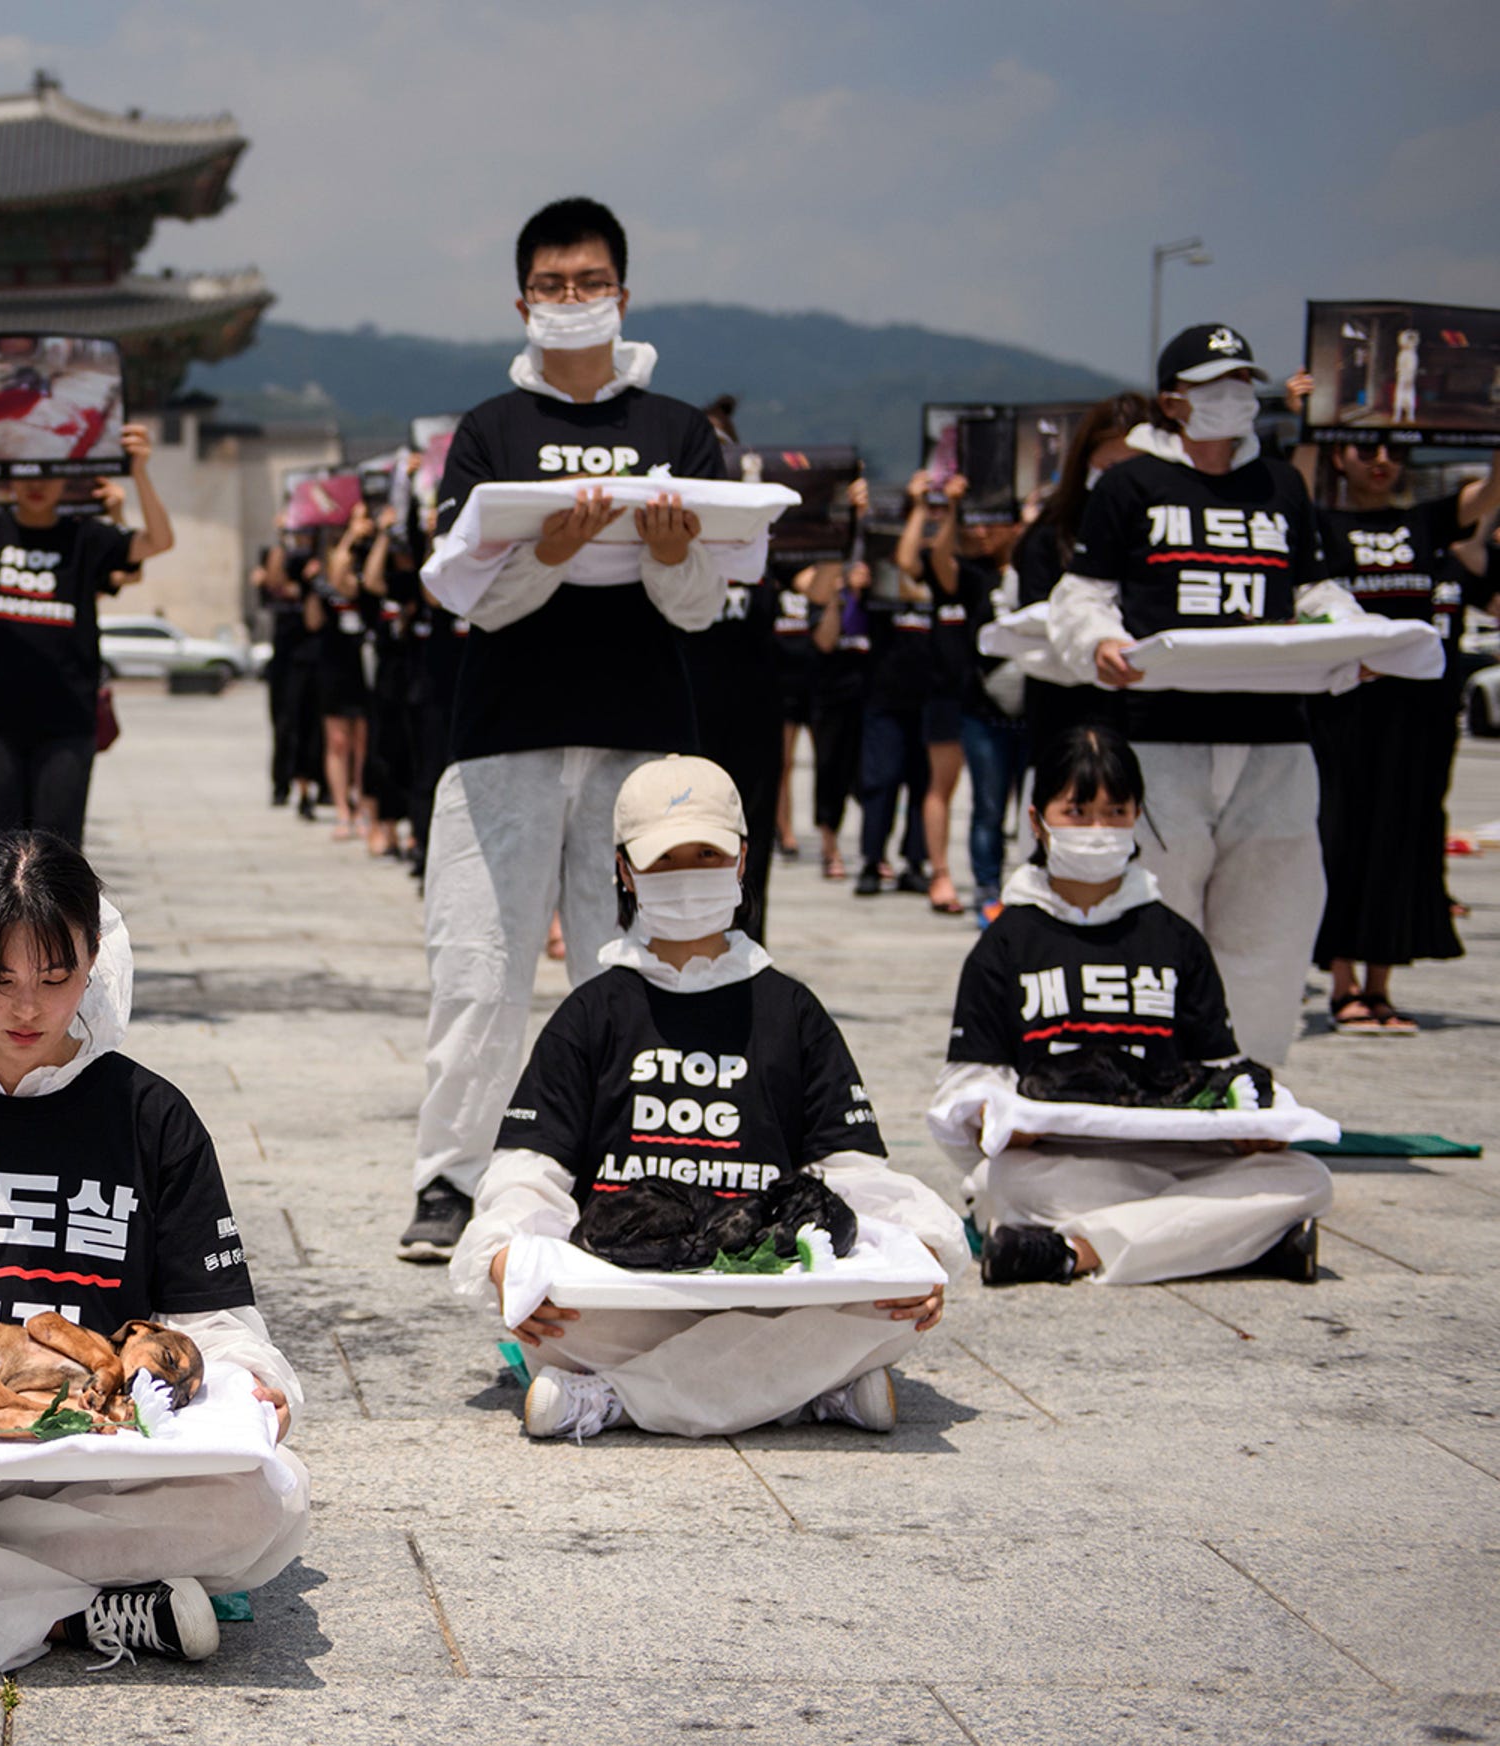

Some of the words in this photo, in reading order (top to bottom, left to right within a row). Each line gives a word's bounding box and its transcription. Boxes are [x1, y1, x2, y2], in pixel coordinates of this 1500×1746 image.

[538, 443, 640, 475] STOP
[1147, 505, 1193, 547] 개
[1204, 508, 1290, 553] 도살
[0, 566, 57, 593] DOG
[1177, 570, 1267, 619] 금지
[1019, 970, 1069, 1021] 개
[1082, 964, 1178, 1019] 도살
[629, 1047, 748, 1089] STOP
[632, 1094, 741, 1137] DOG
[597, 1153, 780, 1191] LAUGHTER
